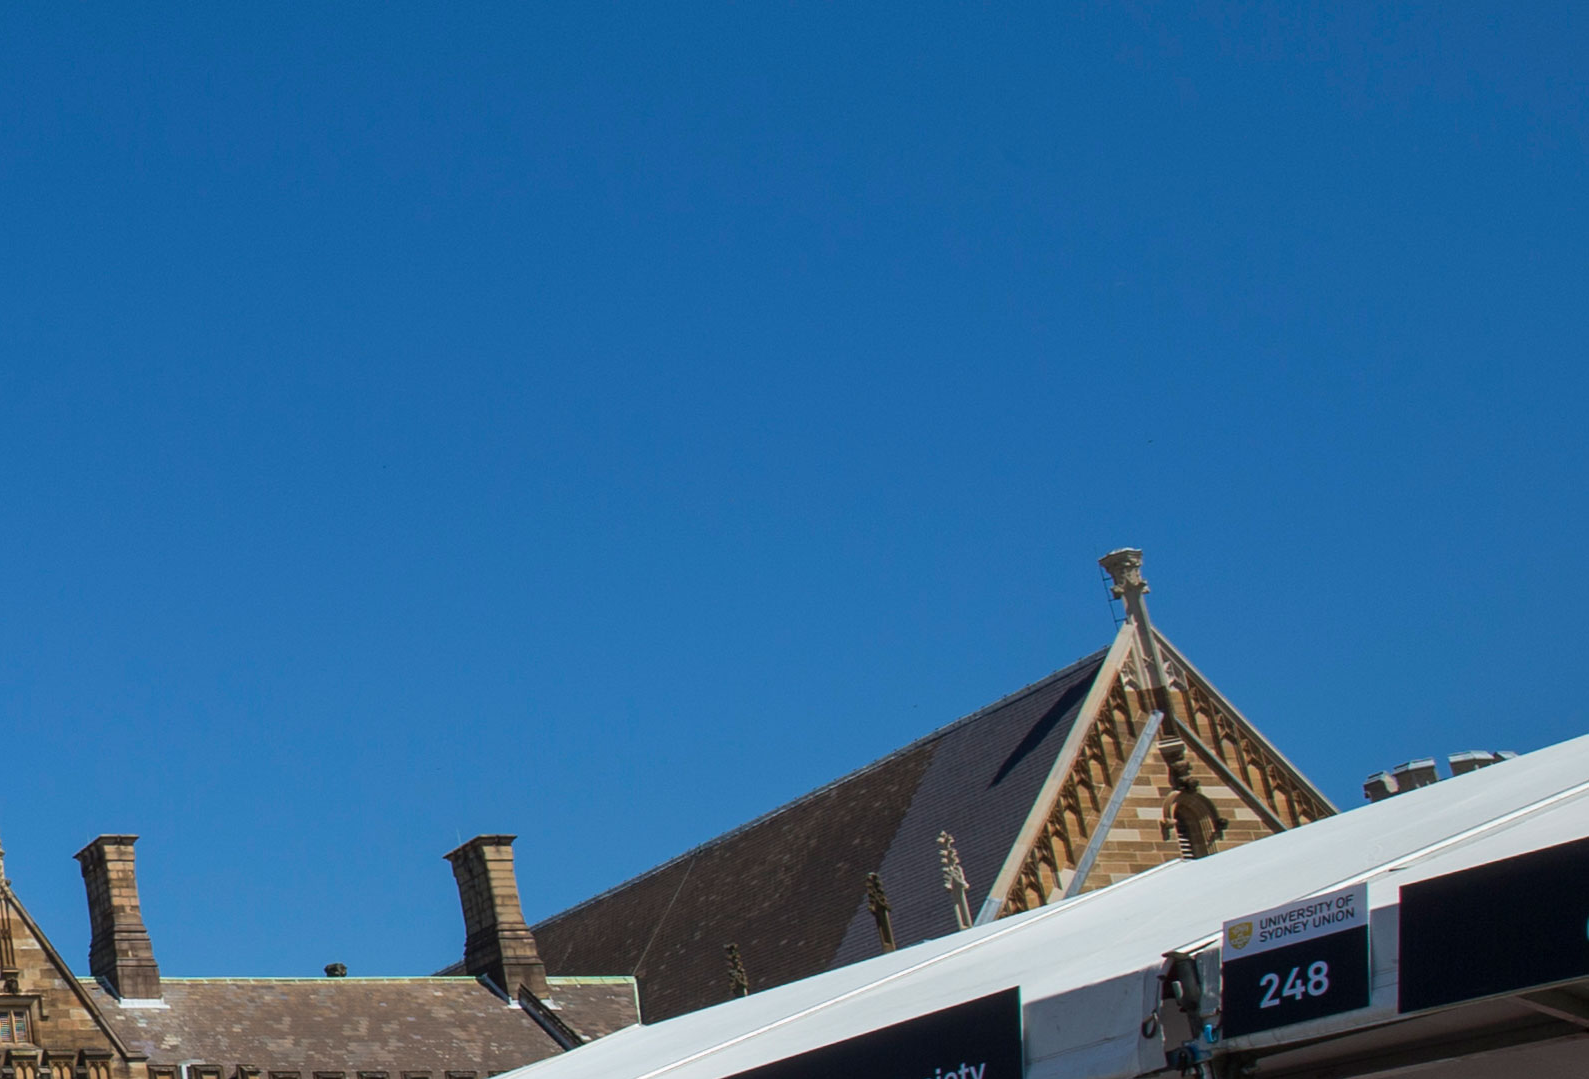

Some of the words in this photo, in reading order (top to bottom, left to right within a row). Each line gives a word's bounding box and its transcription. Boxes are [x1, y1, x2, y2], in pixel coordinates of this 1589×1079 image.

[1259, 898, 1334, 931] UNIVERSITY
[1335, 894, 1355, 909] OF
[1259, 921, 1310, 943] SYDNEY
[1312, 907, 1356, 930] UNION
[1259, 960, 1330, 1009] 248
